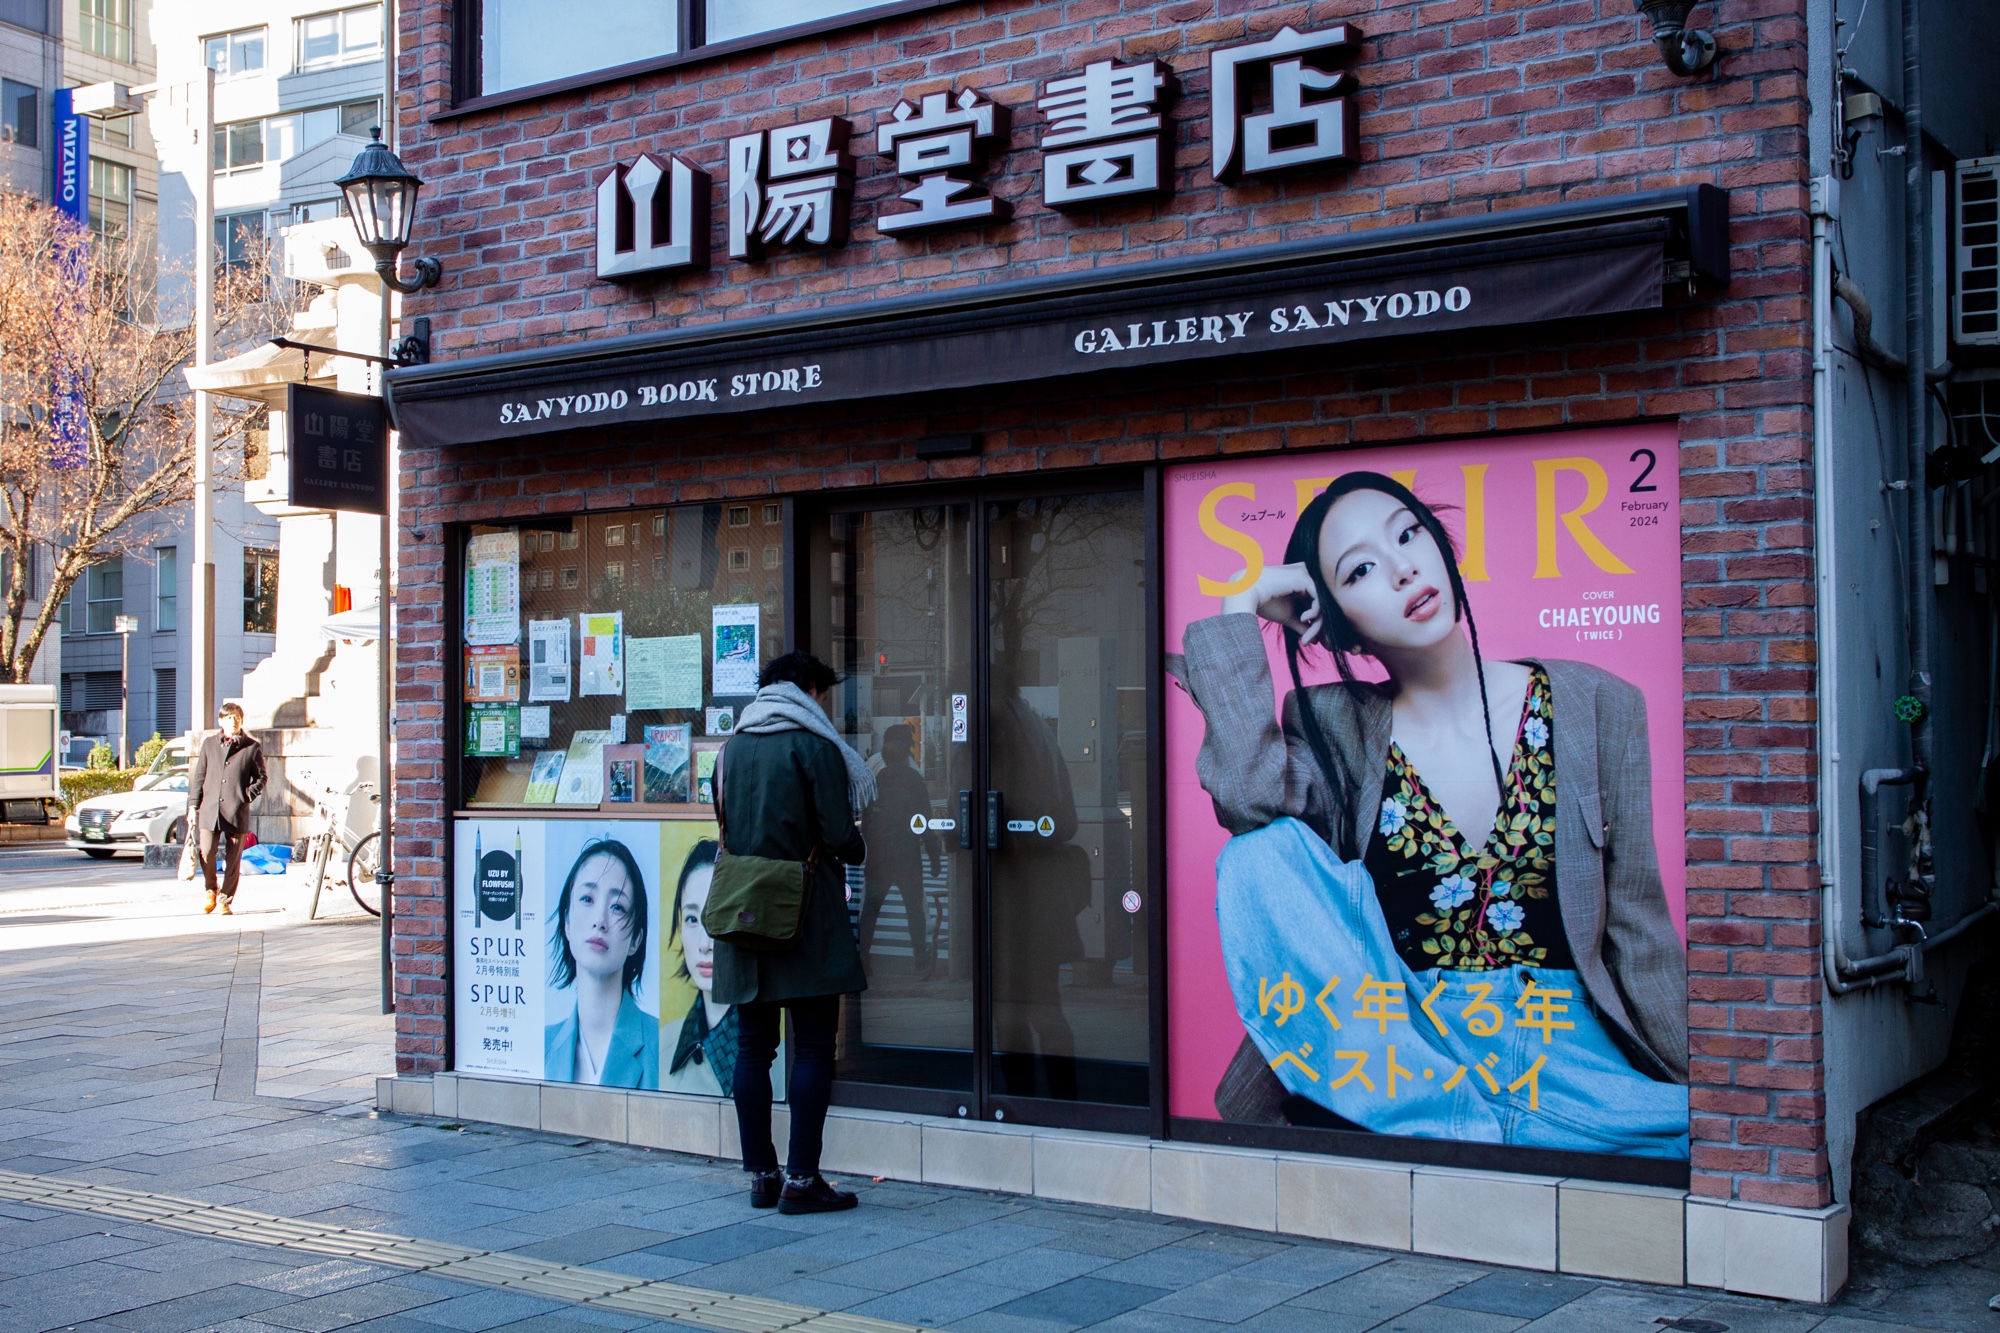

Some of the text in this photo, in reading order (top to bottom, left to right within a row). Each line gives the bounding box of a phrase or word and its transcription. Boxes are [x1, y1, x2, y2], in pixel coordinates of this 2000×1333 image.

[63, 118, 77, 202] MIZUHO
[596, 23, 1352, 280] 山陽堂書店
[1074, 286, 1472, 355] GALLERY SANYODO
[500, 364, 823, 424] SANYODO BOOK STORE
[304, 412, 374, 443] 山陽堂
[318, 445, 362, 473] 書店
[1174, 471, 1217, 482] SHUEISHA
[1629, 448, 1657, 493] 2
[304, 477, 375, 492] GALLERY SANYODO
[1241, 509, 1286, 522] シュプール
[1621, 501, 1669, 512] February
[1629, 515, 1659, 527] 2024
[1582, 591, 1615, 600] COVER
[1538, 603, 1660, 628] CHAEYOUNG
[649, 729, 683, 742] TRANSIT
[487, 870, 509, 878] UZU BY
[482, 880, 515, 889] FLOWFUSHI
[470, 936, 526, 957] SPUR
[475, 965, 520, 978] 2月号特別版
[470, 983, 527, 1005] SPUR
[480, 1006, 516, 1019] 2月号増刊
[1258, 972, 1575, 1045] ゆく年くる年
[482, 1037, 513, 1052] 発売中!
[1269, 1043, 1549, 1111] ベスト・バイ
